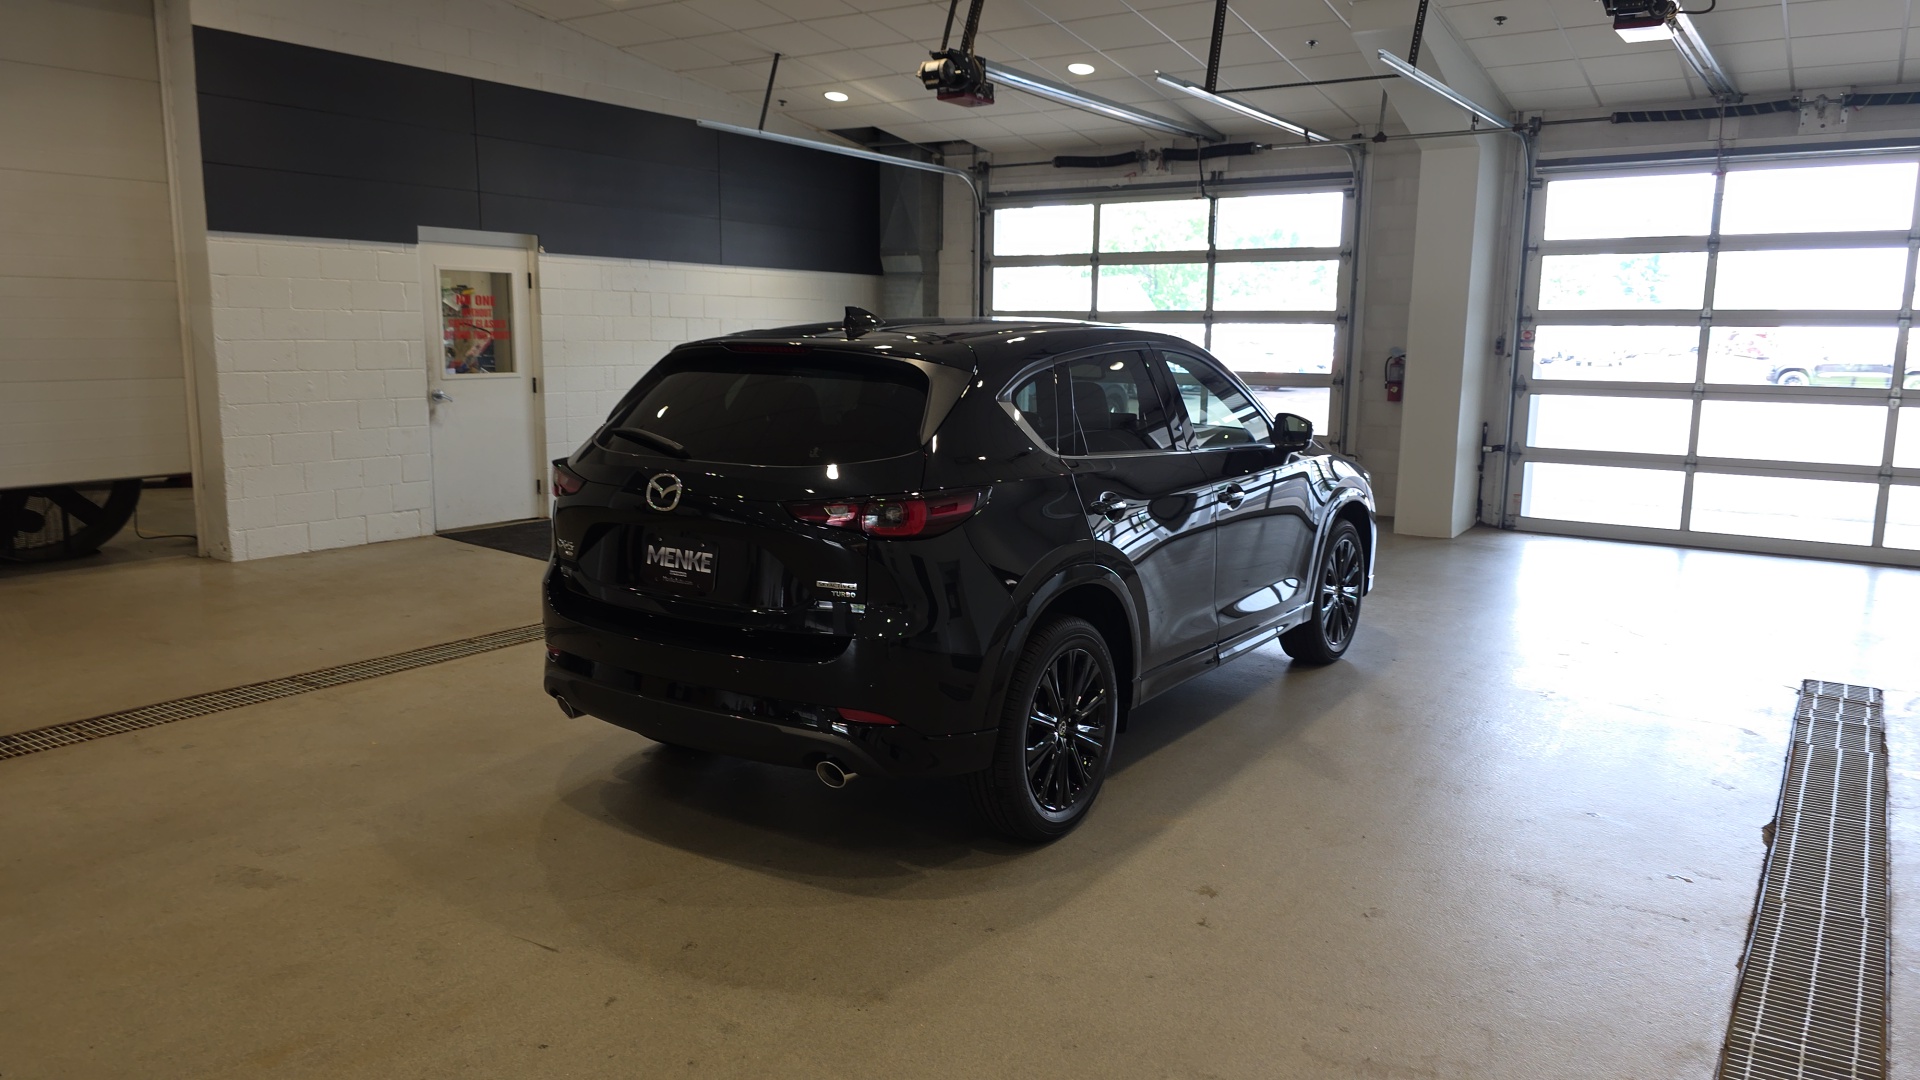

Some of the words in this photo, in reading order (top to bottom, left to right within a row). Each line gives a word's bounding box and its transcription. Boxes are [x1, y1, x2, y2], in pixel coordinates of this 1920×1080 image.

[475, 294, 496, 307] ONE
[646, 544, 713, 574] MENKE
[831, 590, 856, 599] TURBO
